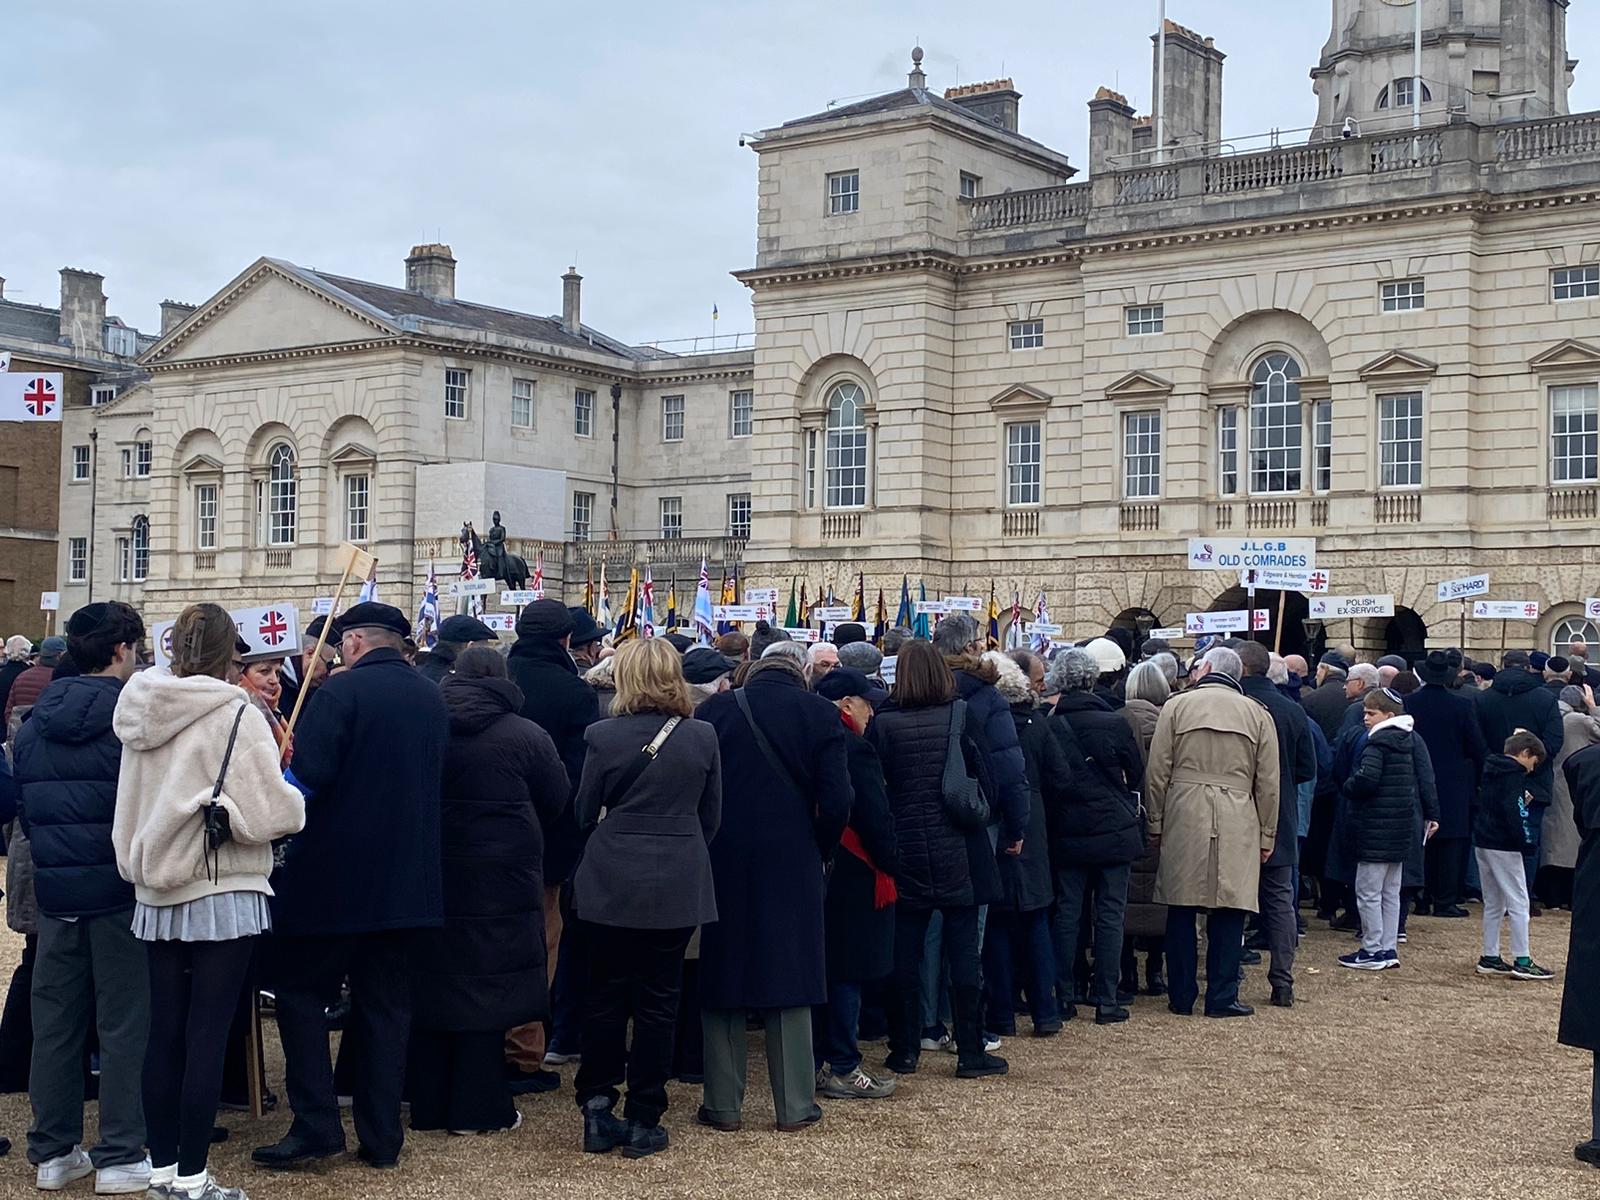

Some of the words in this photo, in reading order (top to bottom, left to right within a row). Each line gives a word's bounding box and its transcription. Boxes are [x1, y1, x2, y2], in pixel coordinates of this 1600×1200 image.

[1240, 542, 1286, 551] J.L.G.B
[1219, 554, 1241, 566] OLD
[1244, 554, 1306, 567] COMRADES
[1337, 606, 1385, 615] EX-SERVICE
[855, 1075, 871, 1089] N
